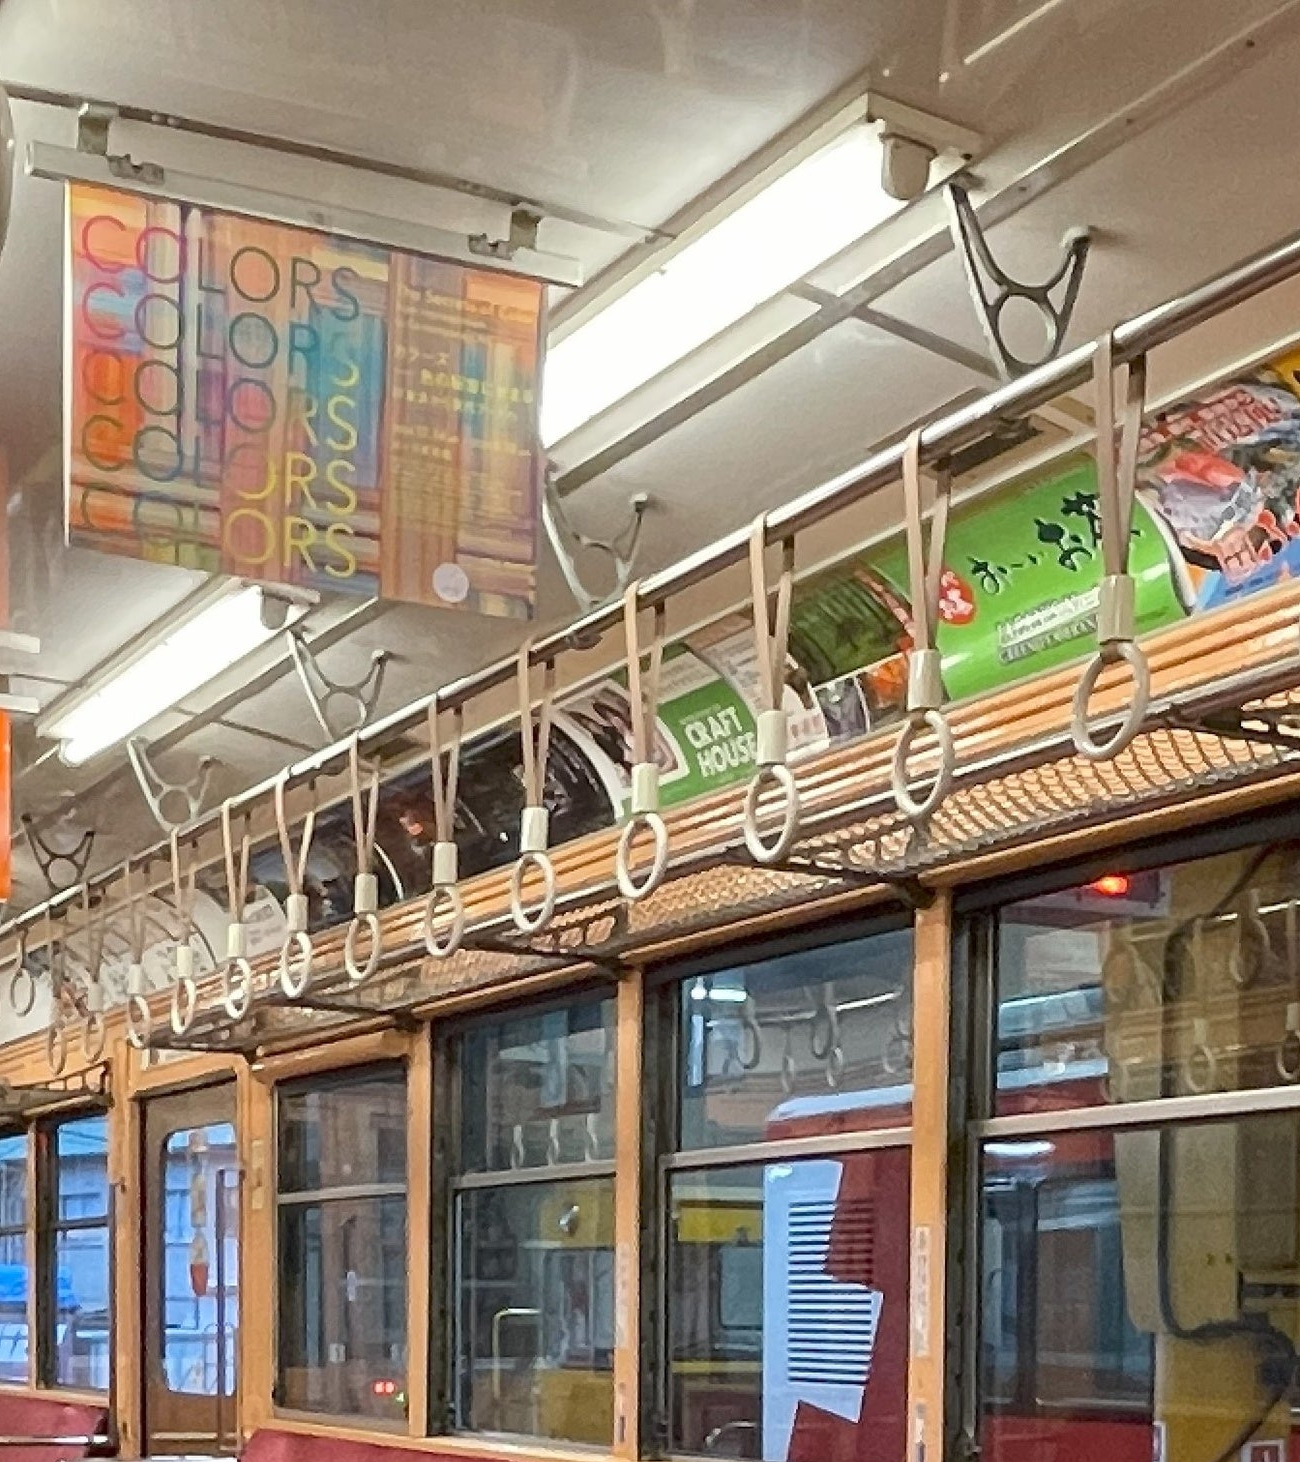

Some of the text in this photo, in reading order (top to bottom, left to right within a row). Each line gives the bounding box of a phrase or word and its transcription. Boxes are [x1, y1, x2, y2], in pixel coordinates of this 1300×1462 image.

[82, 215, 360, 321] COLORS
[83, 282, 360, 388] COLORS
[82, 350, 359, 451] COLORS
[82, 414, 357, 516] COLORS
